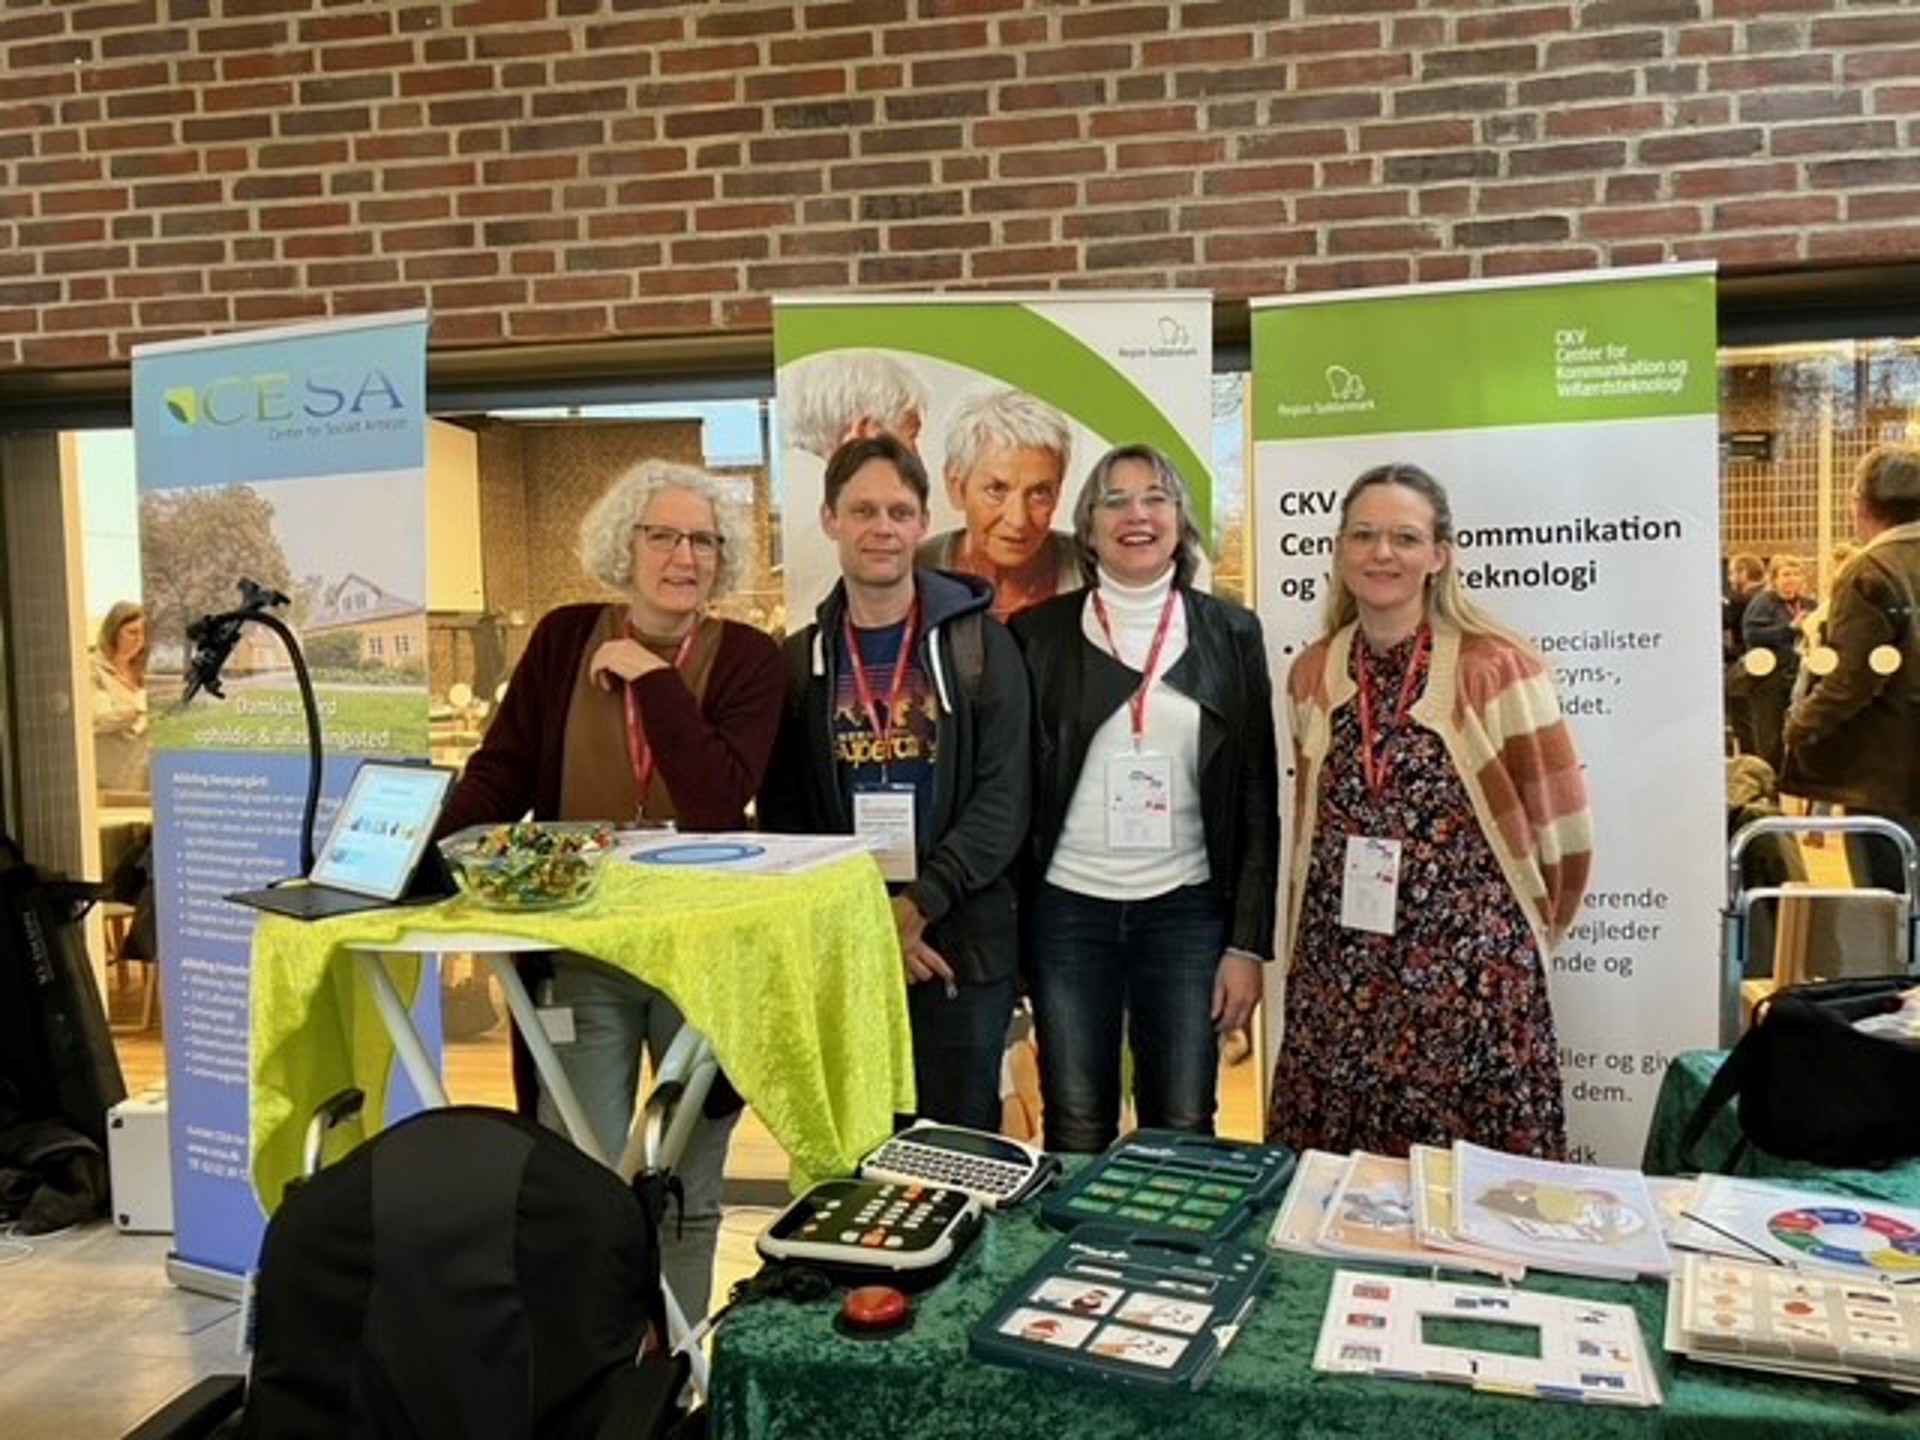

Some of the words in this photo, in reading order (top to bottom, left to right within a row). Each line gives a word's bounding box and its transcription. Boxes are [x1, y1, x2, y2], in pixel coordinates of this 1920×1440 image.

[1556, 328, 1587, 345] CKV
[1556, 346, 1602, 362] Center
[1606, 343, 1629, 359] for
[1556, 359, 1665, 379] Kommunikation
[1667, 359, 1687, 377] og
[203, 366, 404, 427] CESA
[1279, 489, 1336, 517] CKV
[1280, 532, 1334, 556] Cen
[1456, 515, 1683, 549] ommunikation
[1280, 577, 1316, 601] og
[1604, 957, 1633, 977] og
[1604, 1054, 1635, 1075] og
[1571, 1080, 1633, 1102] dem.
